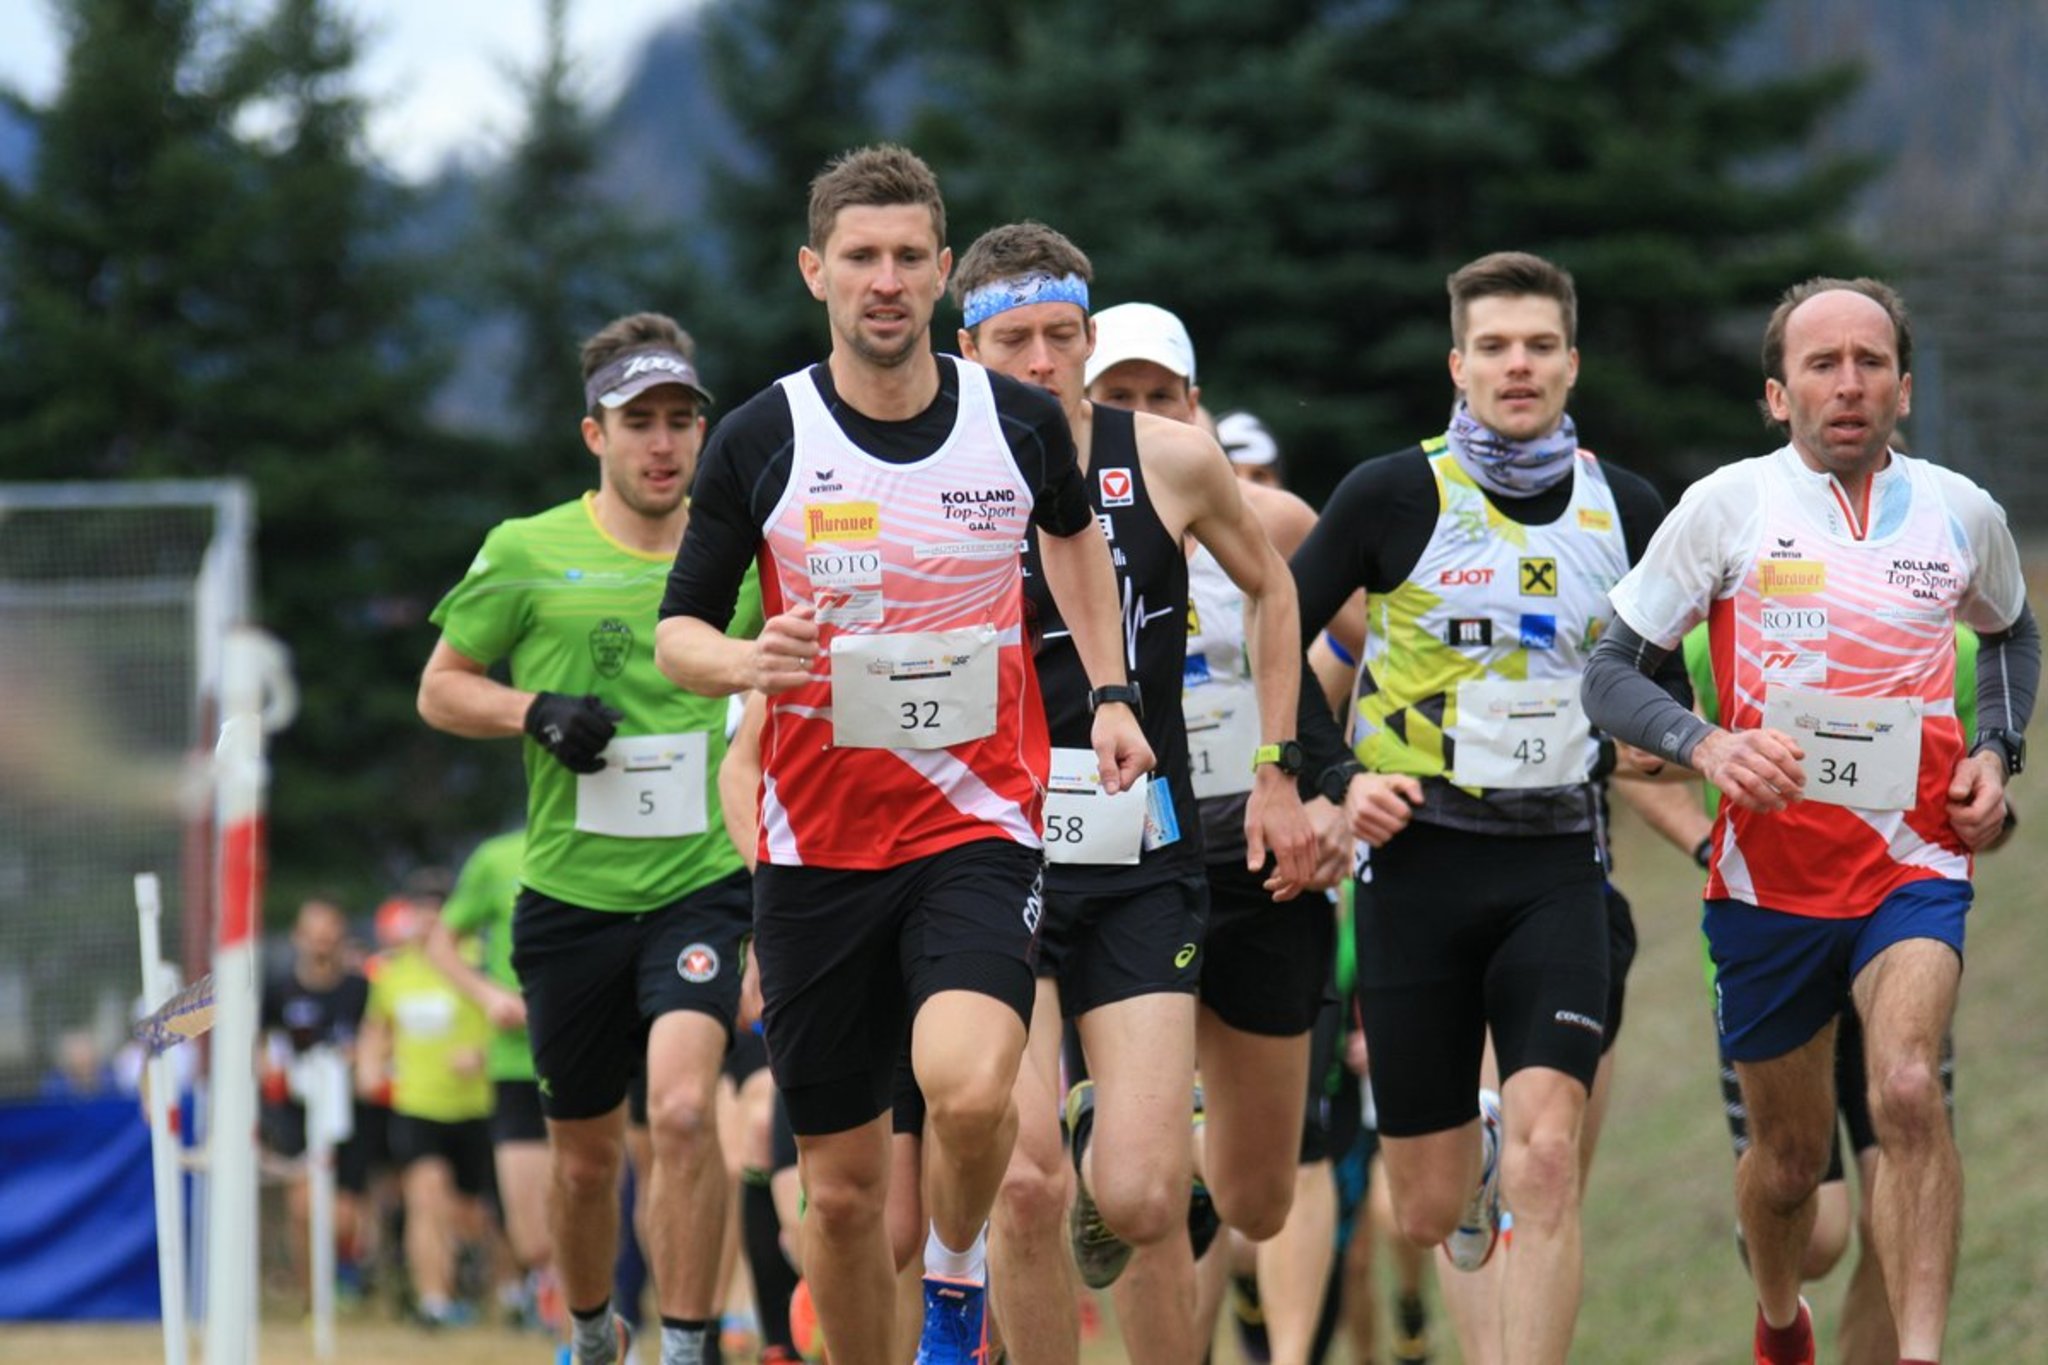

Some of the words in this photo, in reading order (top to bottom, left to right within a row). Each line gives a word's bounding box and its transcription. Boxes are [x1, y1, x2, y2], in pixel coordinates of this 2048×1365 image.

[809, 482, 843, 494] erima
[941, 489, 1015, 503] KOLLAND
[943, 504, 1016, 522] Top-Sport
[809, 509, 874, 540] Murauer
[969, 522, 997, 531] GAAL
[810, 554, 879, 576] ROTO
[1892, 559, 1950, 573] KOLLAND
[1440, 568, 1495, 586] EJOT
[1886, 569, 1958, 590] Top-Sport
[1912, 588, 1941, 600] GAAL
[1763, 610, 1825, 629] ROTO
[900, 700, 941, 729] 32
[1513, 738, 1547, 765] 43
[1818, 758, 1859, 788] 34
[638, 790, 655, 815] 5
[1046, 815, 1084, 843] 58
